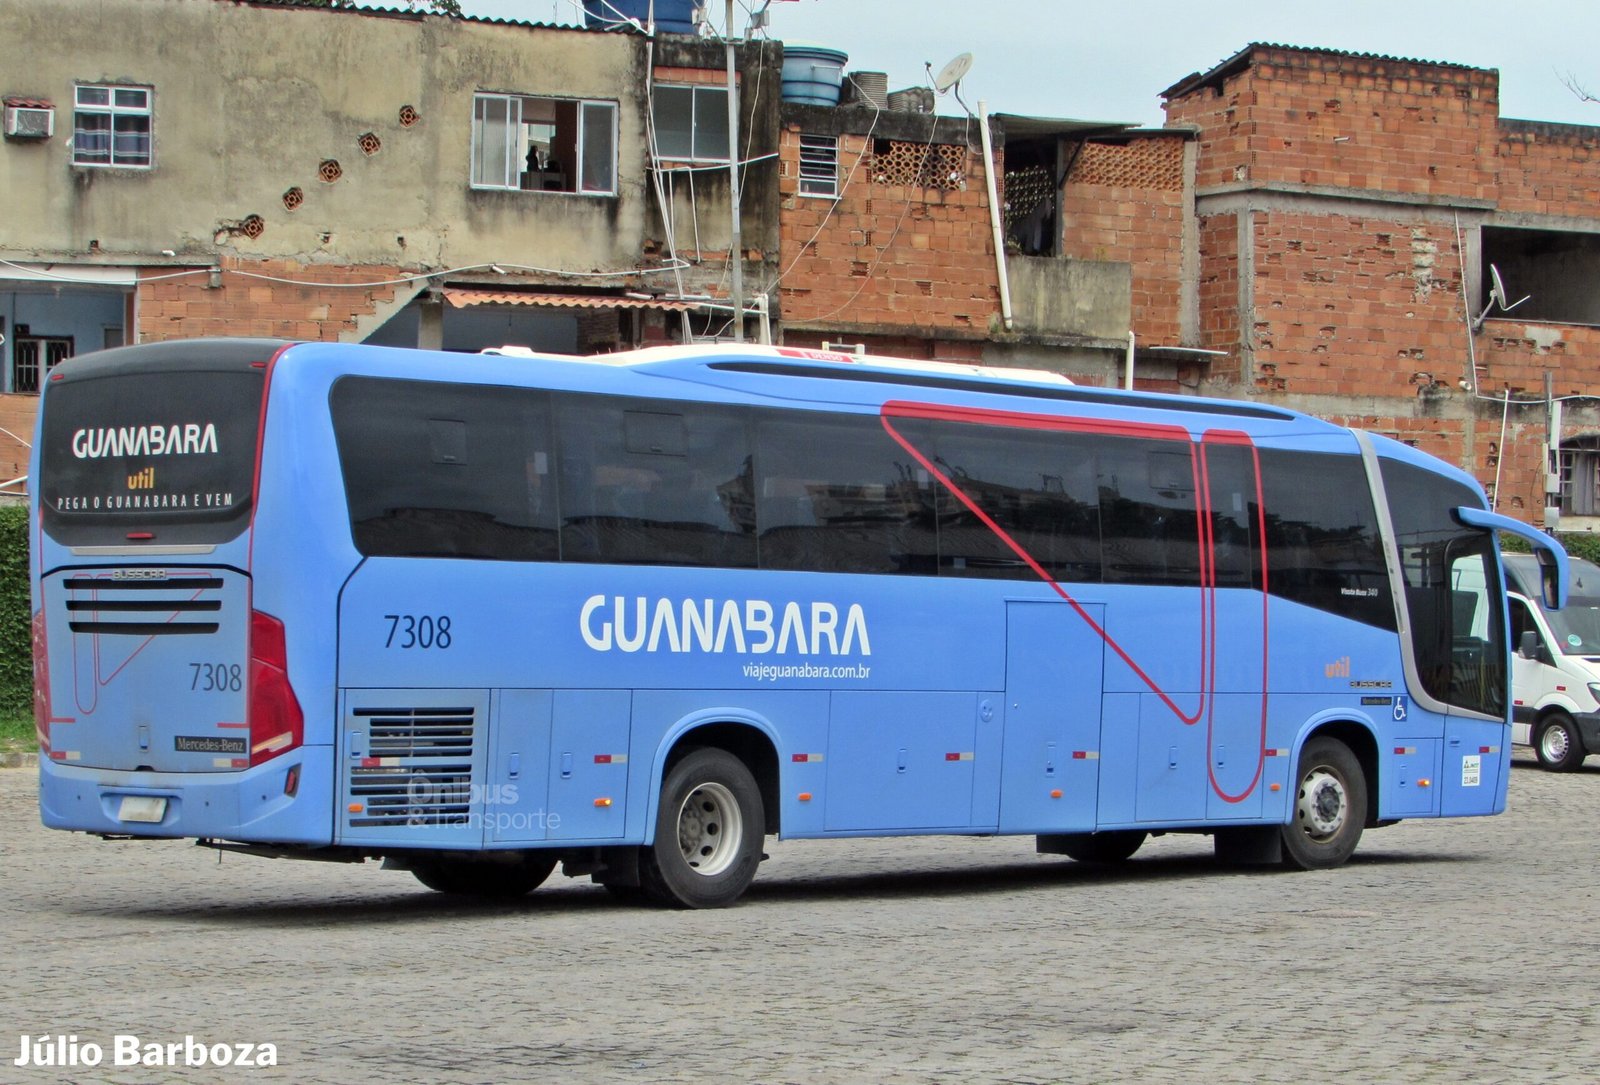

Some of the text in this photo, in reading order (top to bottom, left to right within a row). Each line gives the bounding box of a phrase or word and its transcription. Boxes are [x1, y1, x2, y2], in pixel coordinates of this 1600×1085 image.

[73, 423, 218, 458] GUANABARA
[127, 467, 155, 489] util
[58, 493, 233, 510] PEGA O GUANABARA E VEM
[384, 614, 451, 649] 7308
[580, 594, 871, 656] GUANABARA
[189, 663, 242, 691] 7308
[743, 662, 871, 681] viajeguanabara.com.br
[1325, 656, 1350, 678] util
[178, 737, 244, 752] Mercedes-Benz
